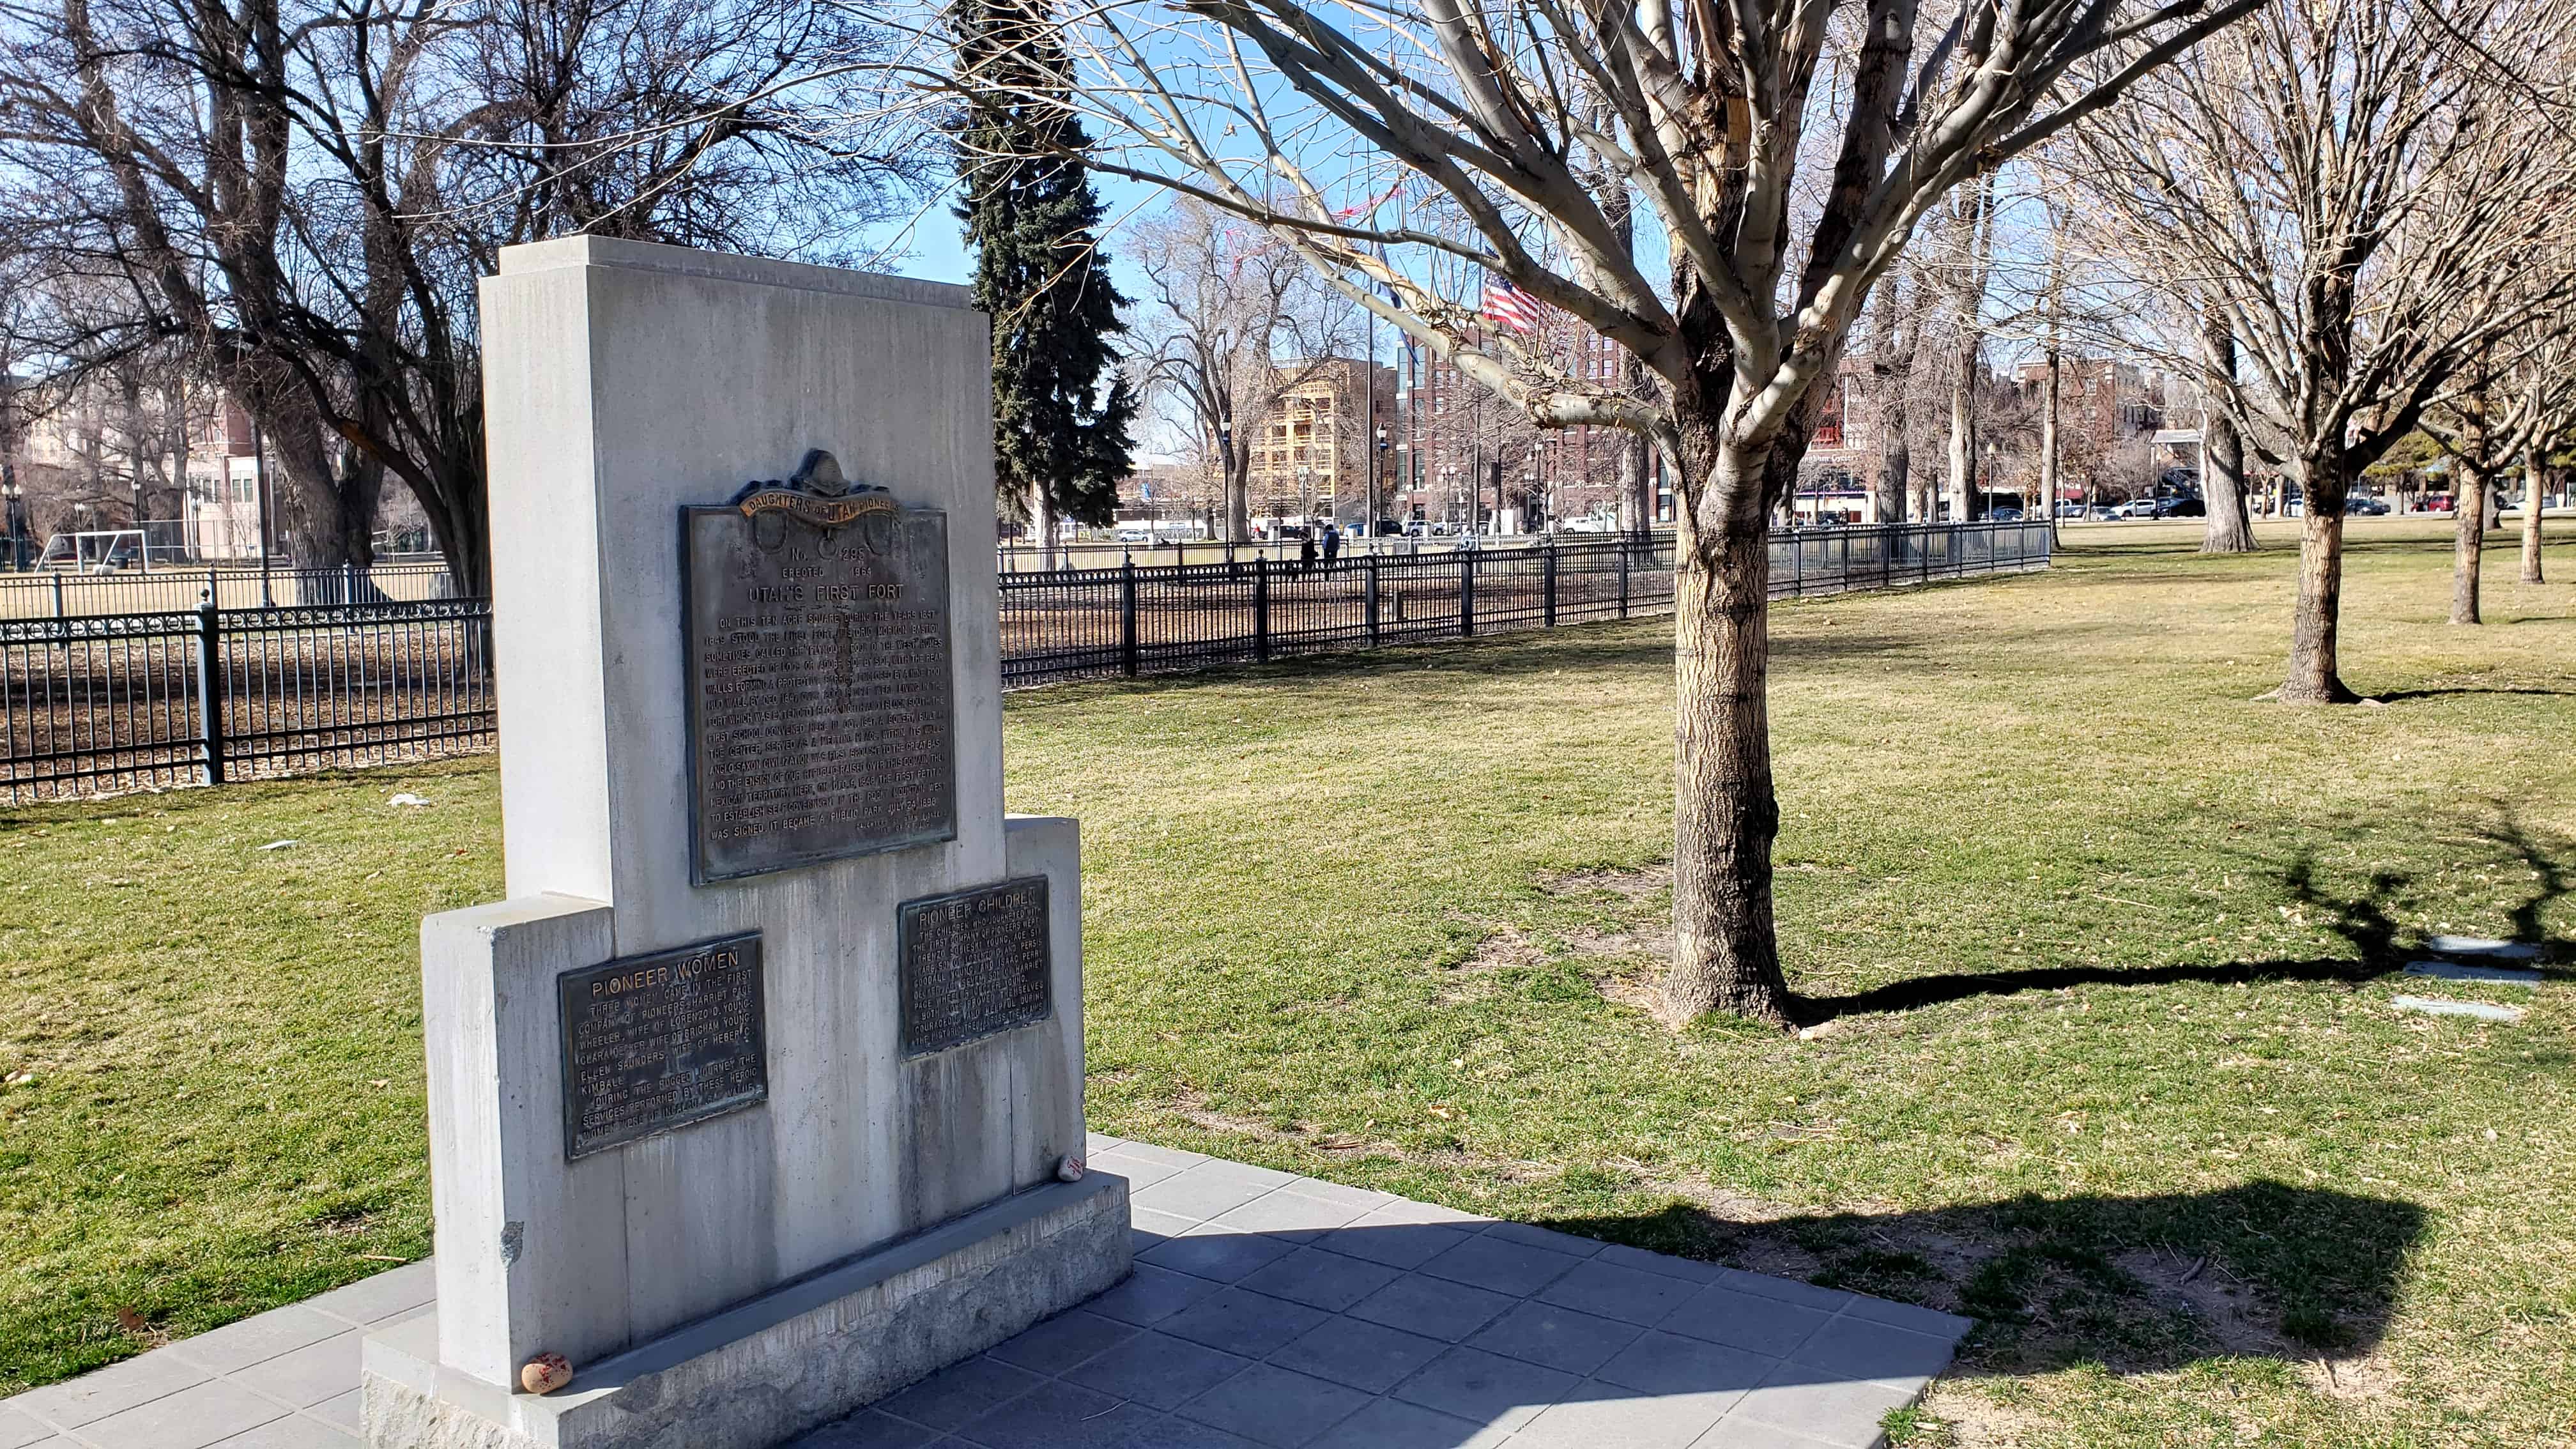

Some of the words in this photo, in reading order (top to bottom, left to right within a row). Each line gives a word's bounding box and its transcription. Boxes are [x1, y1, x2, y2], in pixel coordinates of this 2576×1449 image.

[749, 493, 811, 514] DAUGHTERS
[828, 503, 857, 521] UTAH
[747, 586, 803, 604] UTAH'S
[816, 584, 859, 601] FIRST
[869, 582, 903, 599] FORT
[735, 617, 756, 629] THIS
[874, 610, 890, 621] THE
[919, 902, 971, 926] PIONEER
[978, 889, 1036, 914] CHILDREN
[592, 966, 667, 998] PIONEER
[677, 950, 739, 979] WOMEN
[726, 969, 751, 985] FIRST
